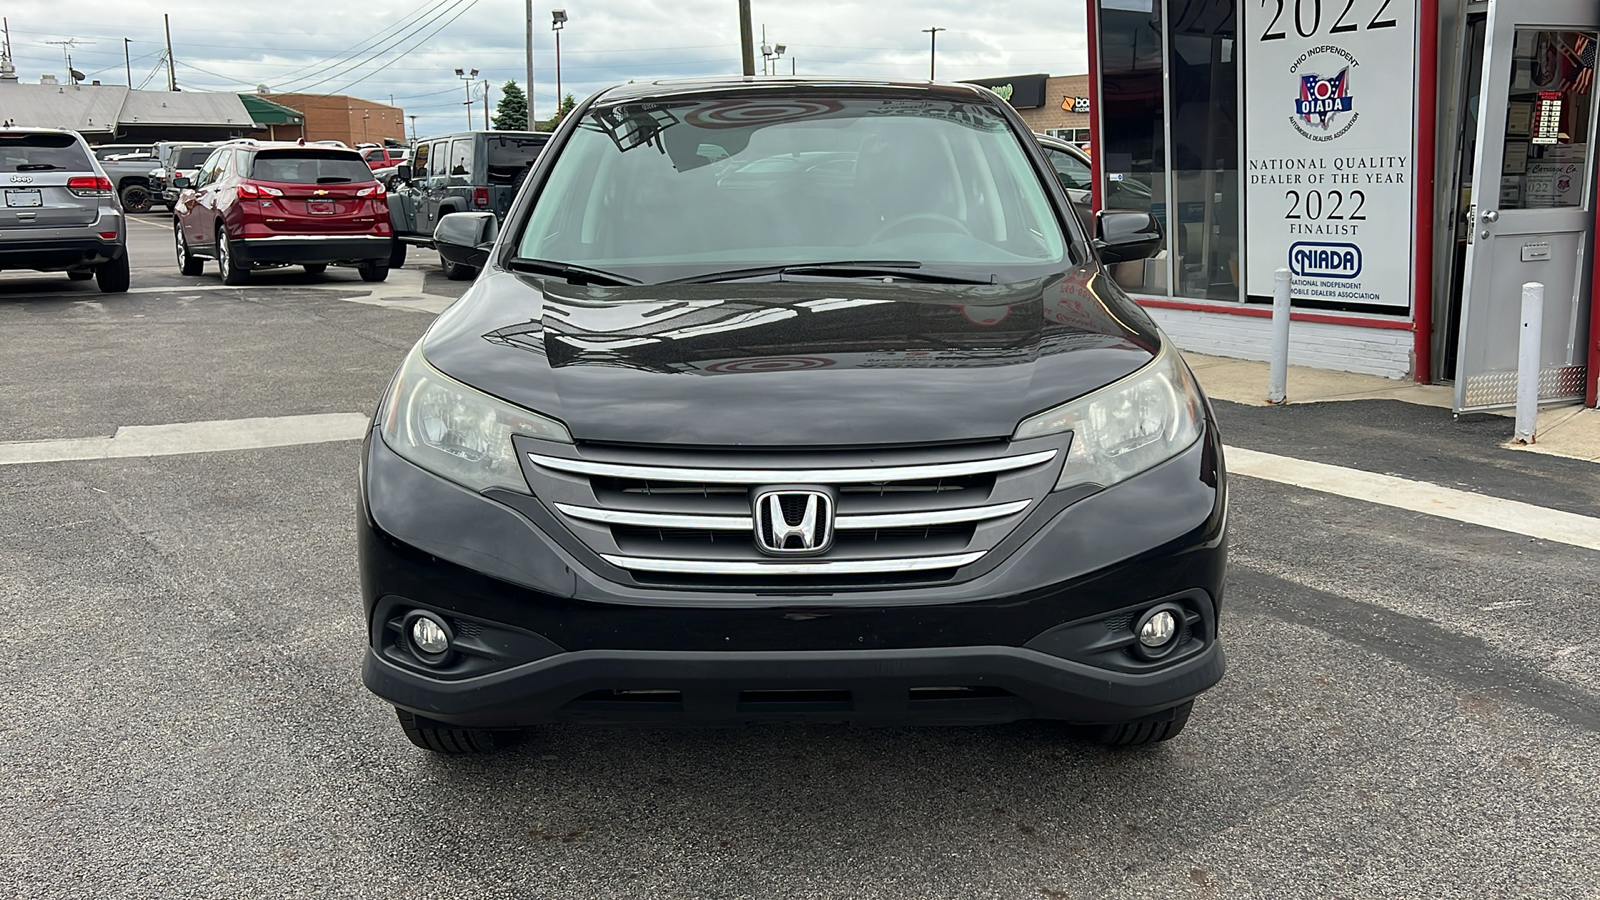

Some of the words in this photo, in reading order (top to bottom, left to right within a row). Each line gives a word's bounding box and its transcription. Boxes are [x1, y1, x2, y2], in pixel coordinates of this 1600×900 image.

[1260, 0, 1397, 41] 2022
[1290, 53, 1307, 74] OHIO
[1307, 45, 1360, 69] INDEPENDENT
[1075, 97, 1089, 107] bo
[1302, 98, 1343, 113] OIADA
[1289, 116, 1312, 140] AUTOMOBILE
[1312, 134, 1334, 142] DEALERS
[1333, 112, 1360, 140] ASSOCIATION
[1250, 158, 1327, 170] NATIONAL
[1334, 156, 1408, 171] QUALITY
[10, 174, 33, 184] Jeep
[1251, 174, 1302, 184] DEALER
[1308, 174, 1325, 184] OF
[1331, 173, 1359, 184] THE
[1366, 172, 1405, 184] YEAR
[1525, 183, 1548, 193] 022
[1284, 189, 1367, 221] 2022
[1290, 223, 1359, 235] FINALIST
[1294, 249, 1355, 271] NIADA
[1320, 281, 1361, 290] INDEPENDENT
[1311, 289, 1336, 297] DEALERS
[1337, 291, 1380, 300] ASSOCIATION
